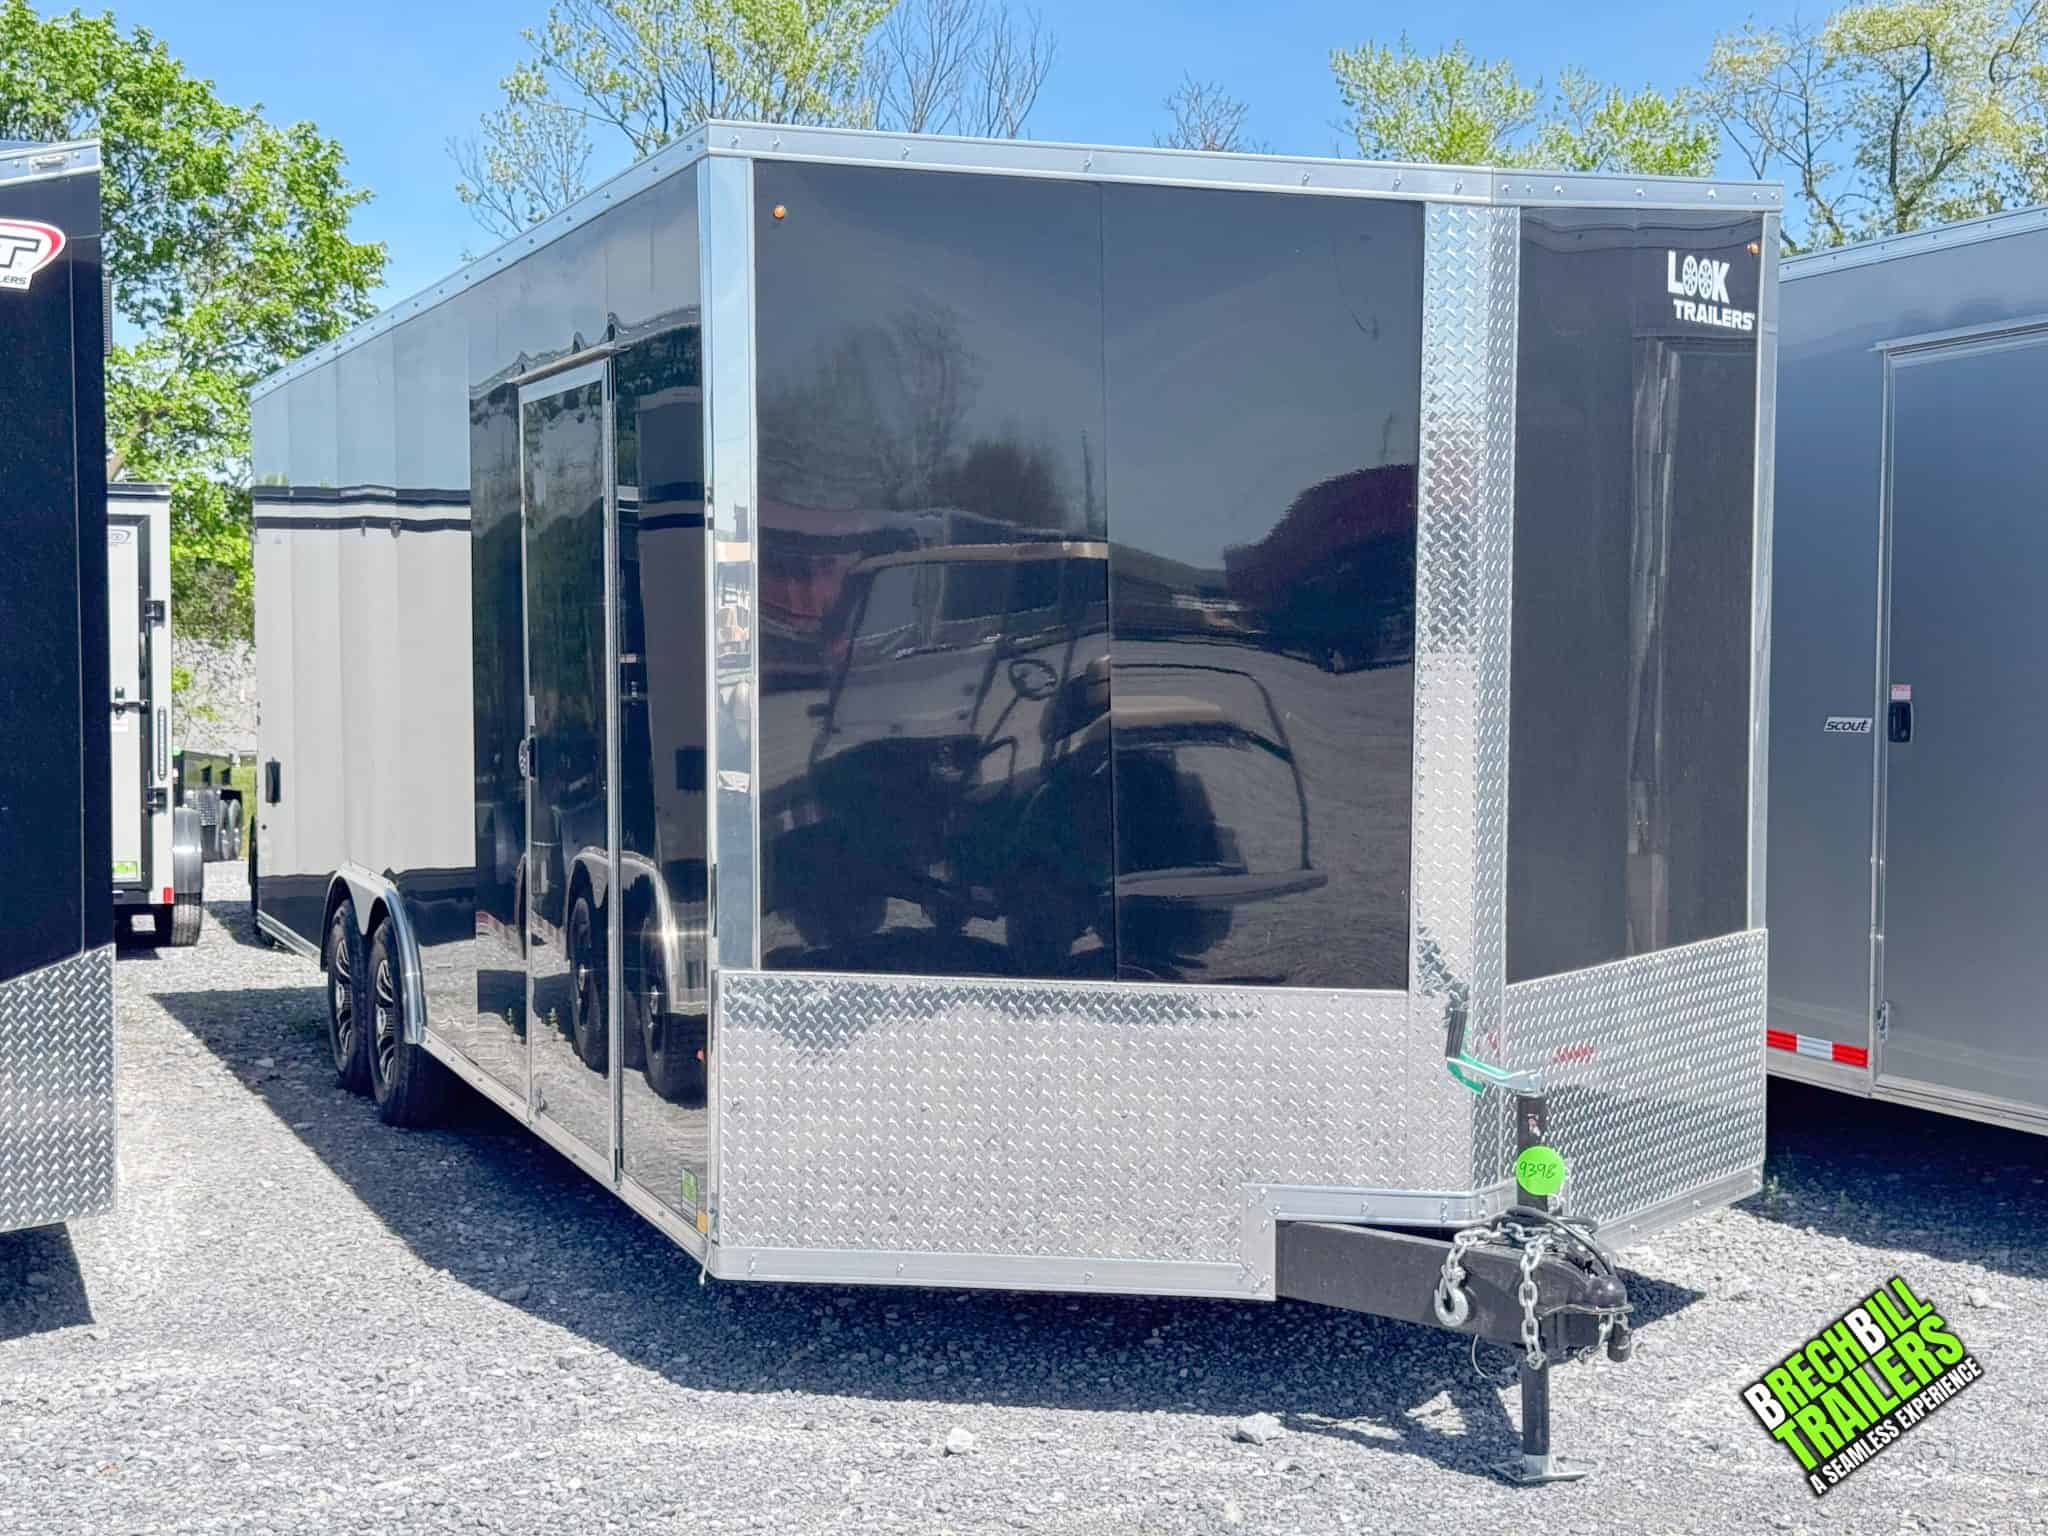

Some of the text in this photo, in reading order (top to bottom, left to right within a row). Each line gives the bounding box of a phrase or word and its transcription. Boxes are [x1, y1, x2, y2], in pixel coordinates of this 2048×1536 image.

[1667, 249, 1730, 304] LOOK
[1673, 299, 1754, 331] TRAILERS
[1826, 719, 1868, 731] scout
